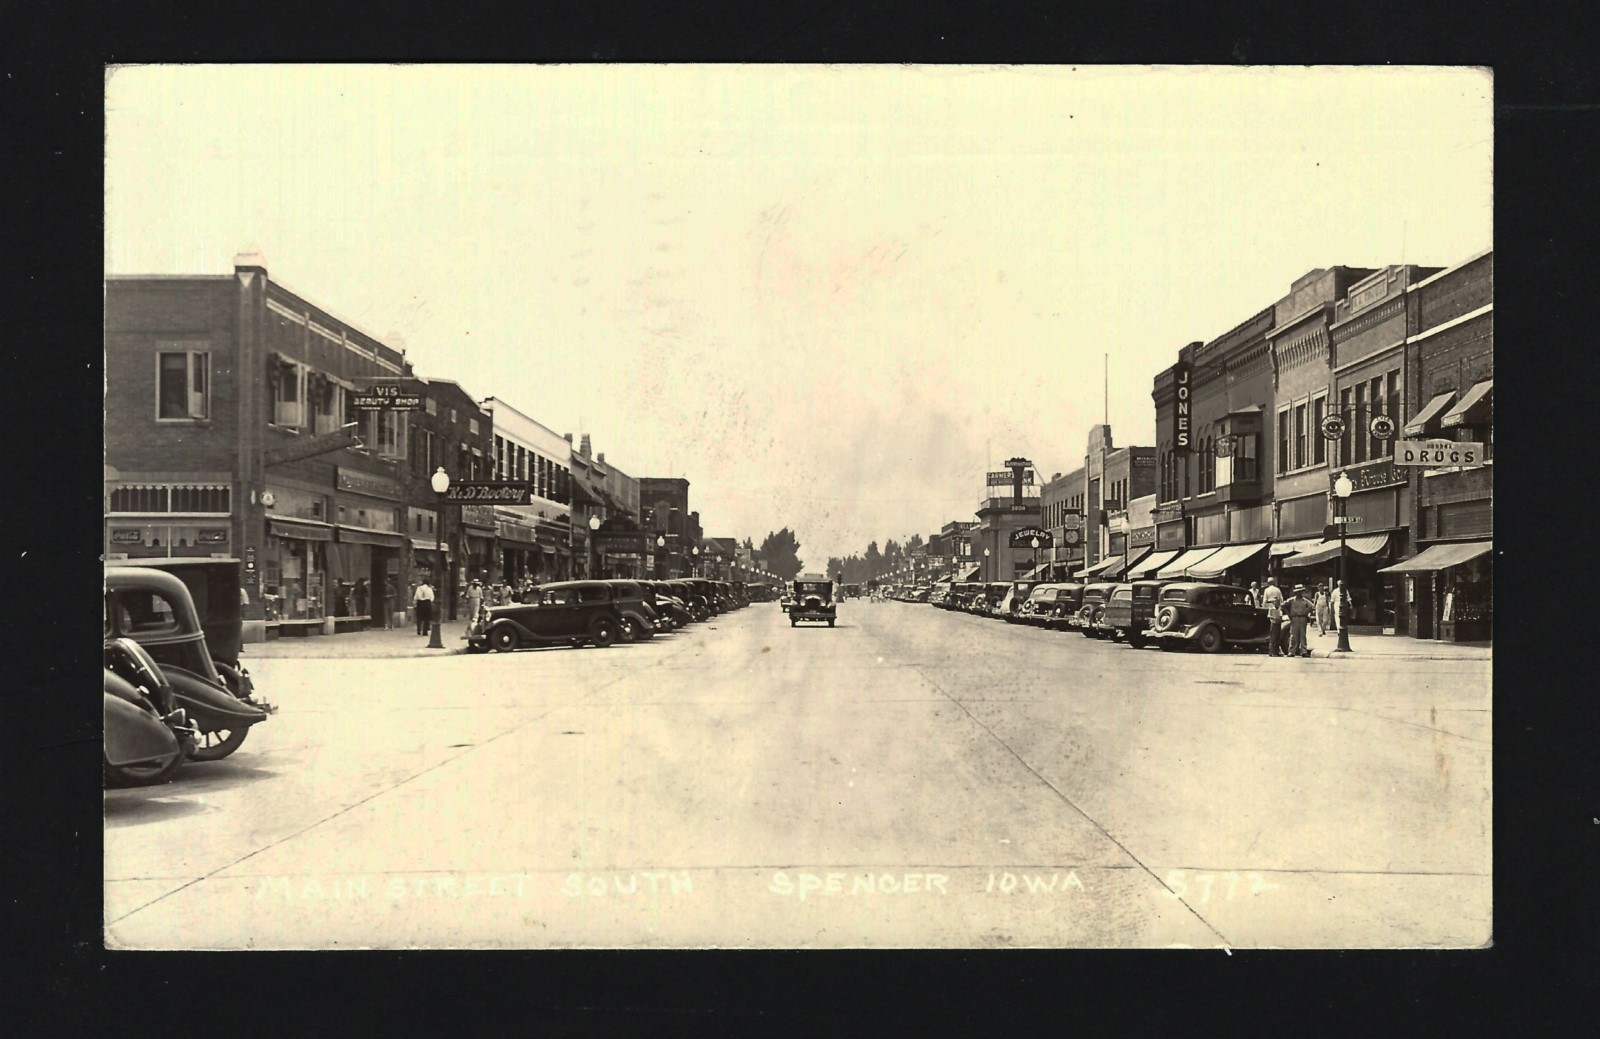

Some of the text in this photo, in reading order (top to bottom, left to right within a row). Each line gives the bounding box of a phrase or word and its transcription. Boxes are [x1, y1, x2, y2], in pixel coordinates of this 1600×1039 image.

[376, 386, 398, 397] VIS
[353, 397, 419, 406] BEAUTY SHOP
[1178, 371, 1189, 446] JONES
[1404, 449, 1475, 464] DRUGS
[477, 486, 525, 503] Bootery
[1014, 529, 1051, 541] JEWELRY
